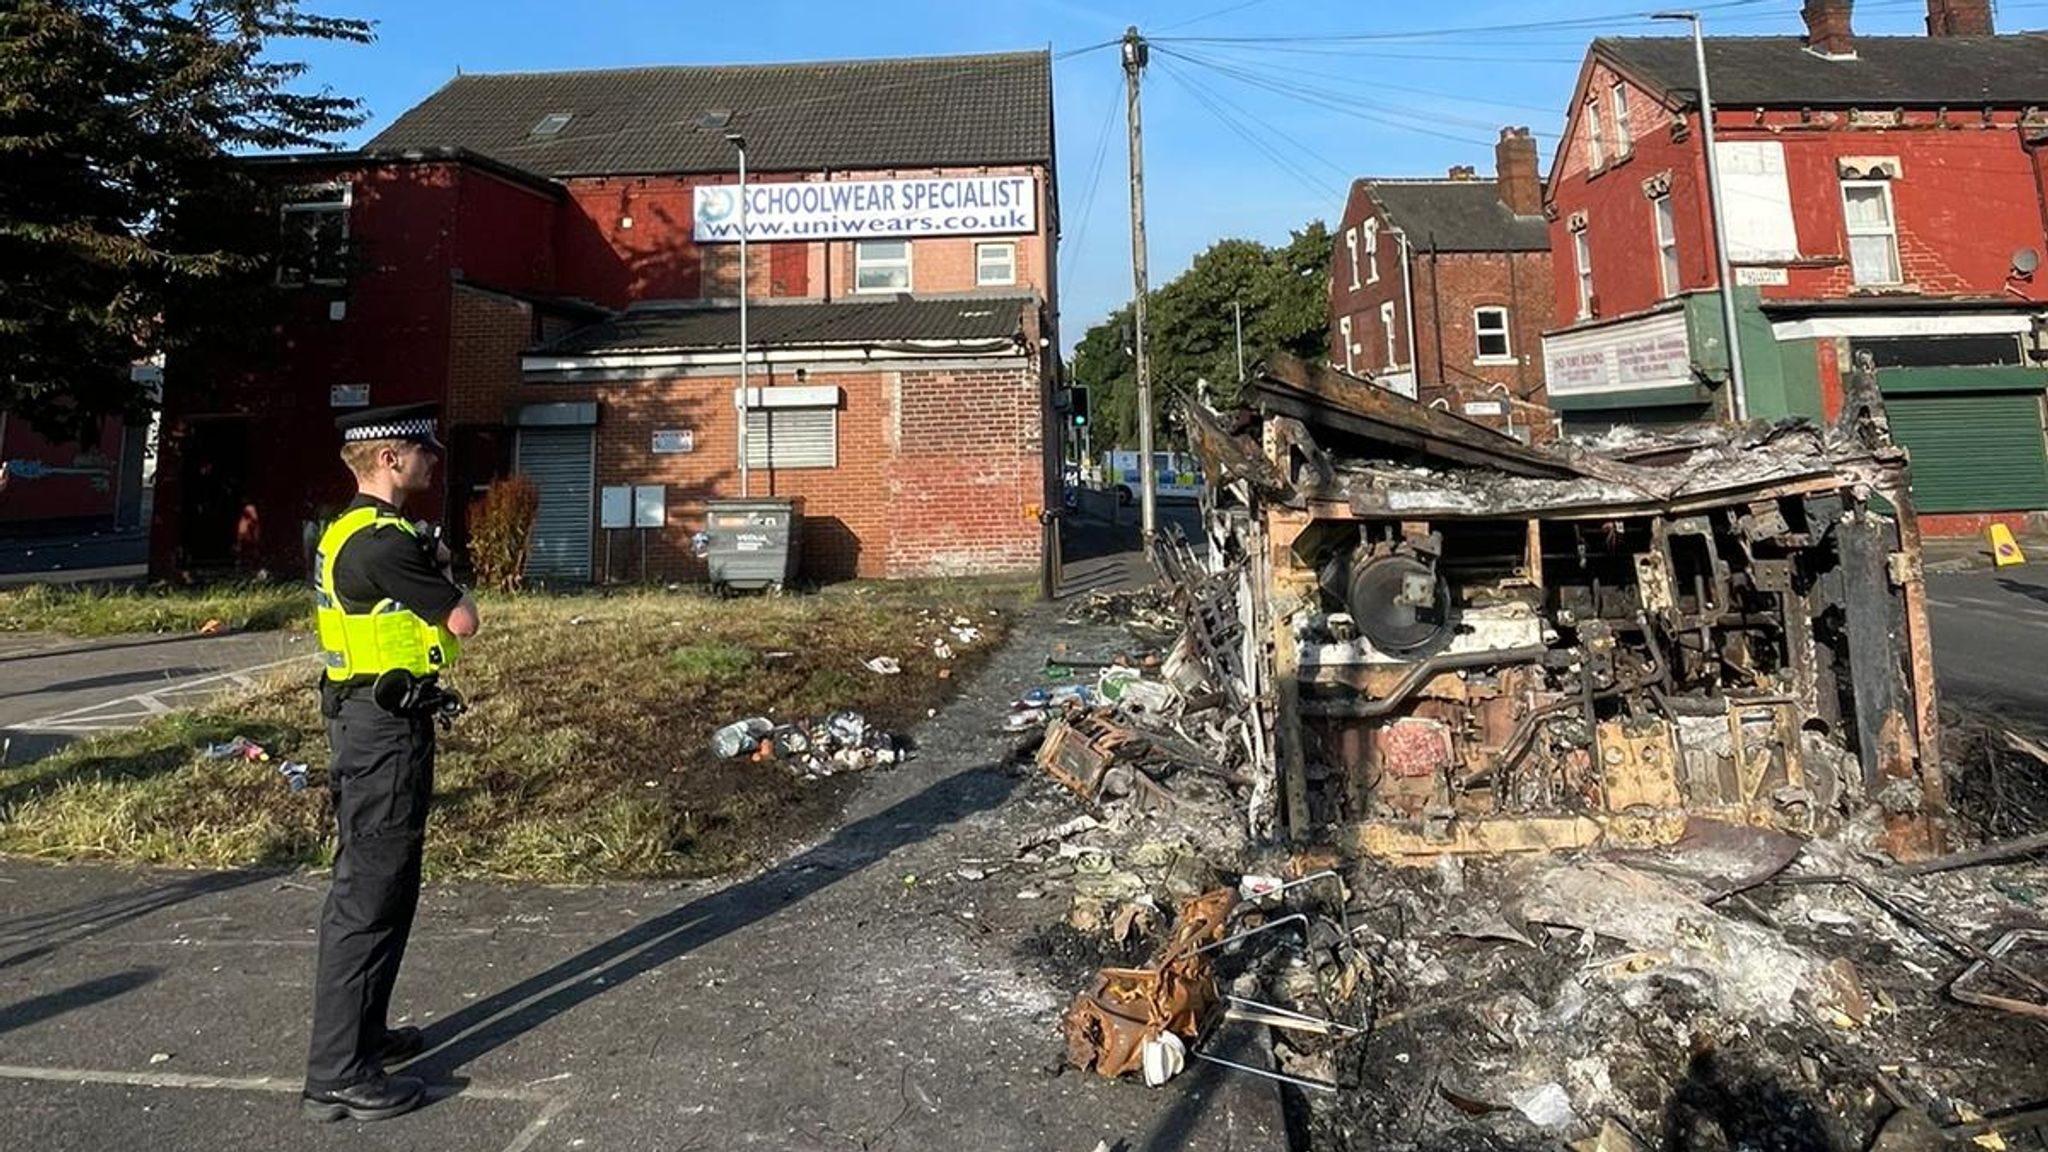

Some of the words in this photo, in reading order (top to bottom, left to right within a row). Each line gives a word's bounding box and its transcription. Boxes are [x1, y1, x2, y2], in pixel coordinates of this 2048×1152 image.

[741, 181, 896, 216] SCHOOLWEAR
[902, 179, 1026, 209] SPECIALIST
[706, 209, 1027, 237] www.uniwears.co.uk
